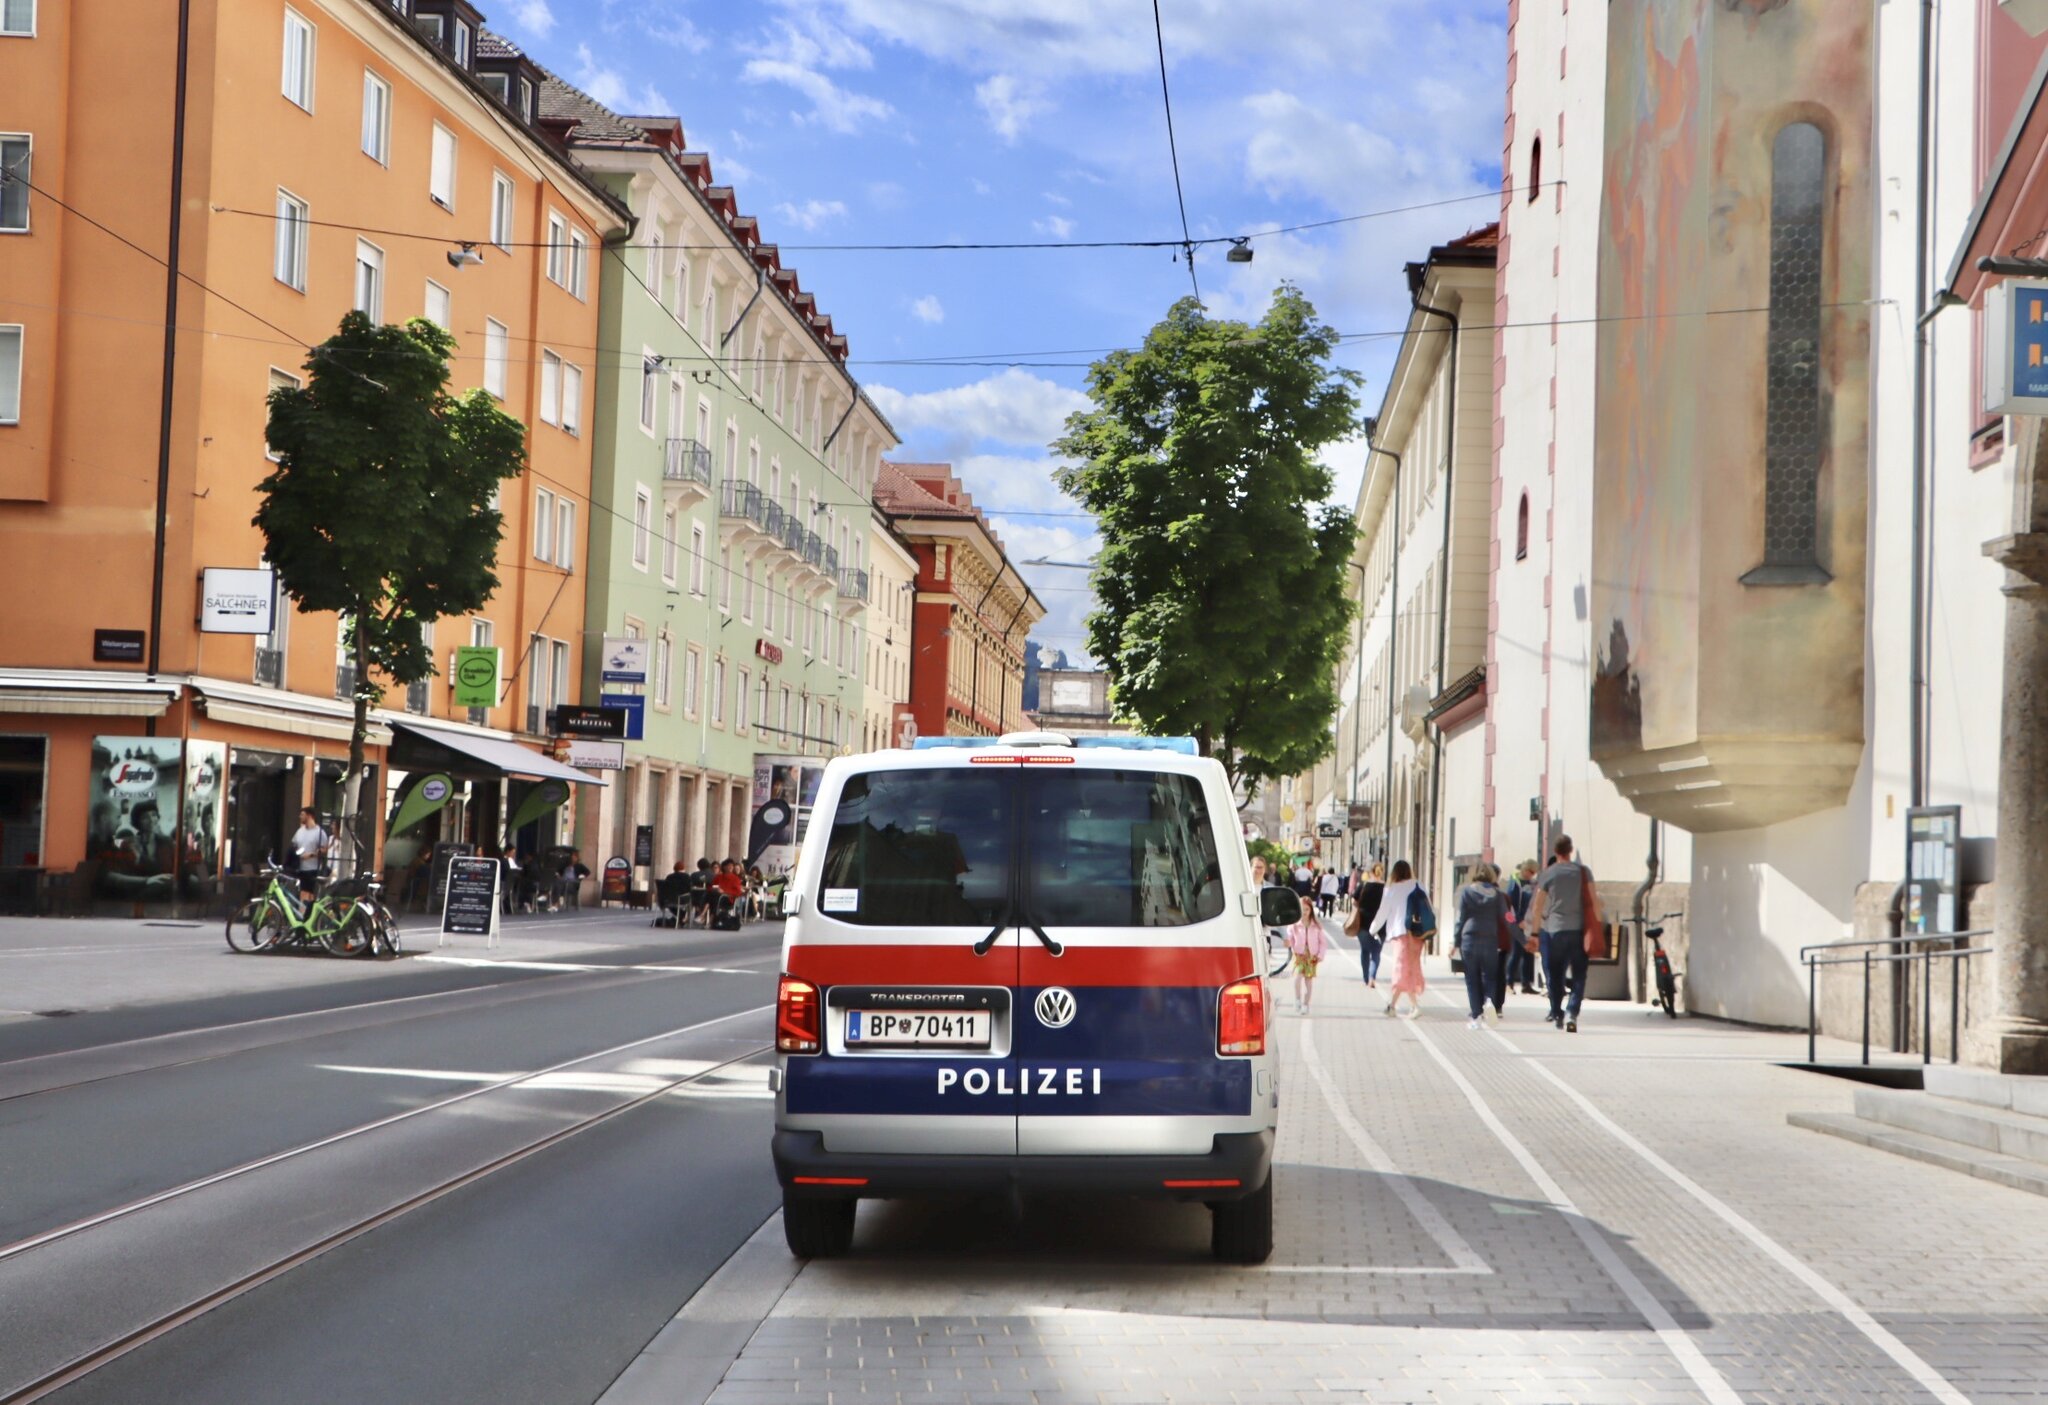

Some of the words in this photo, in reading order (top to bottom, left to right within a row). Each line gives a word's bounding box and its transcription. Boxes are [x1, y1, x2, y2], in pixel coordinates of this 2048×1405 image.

[206, 597, 267, 609] SALCHNER
[870, 993, 965, 1002] TRANSPORTER
[937, 1067, 1102, 1095] POLIZEI
